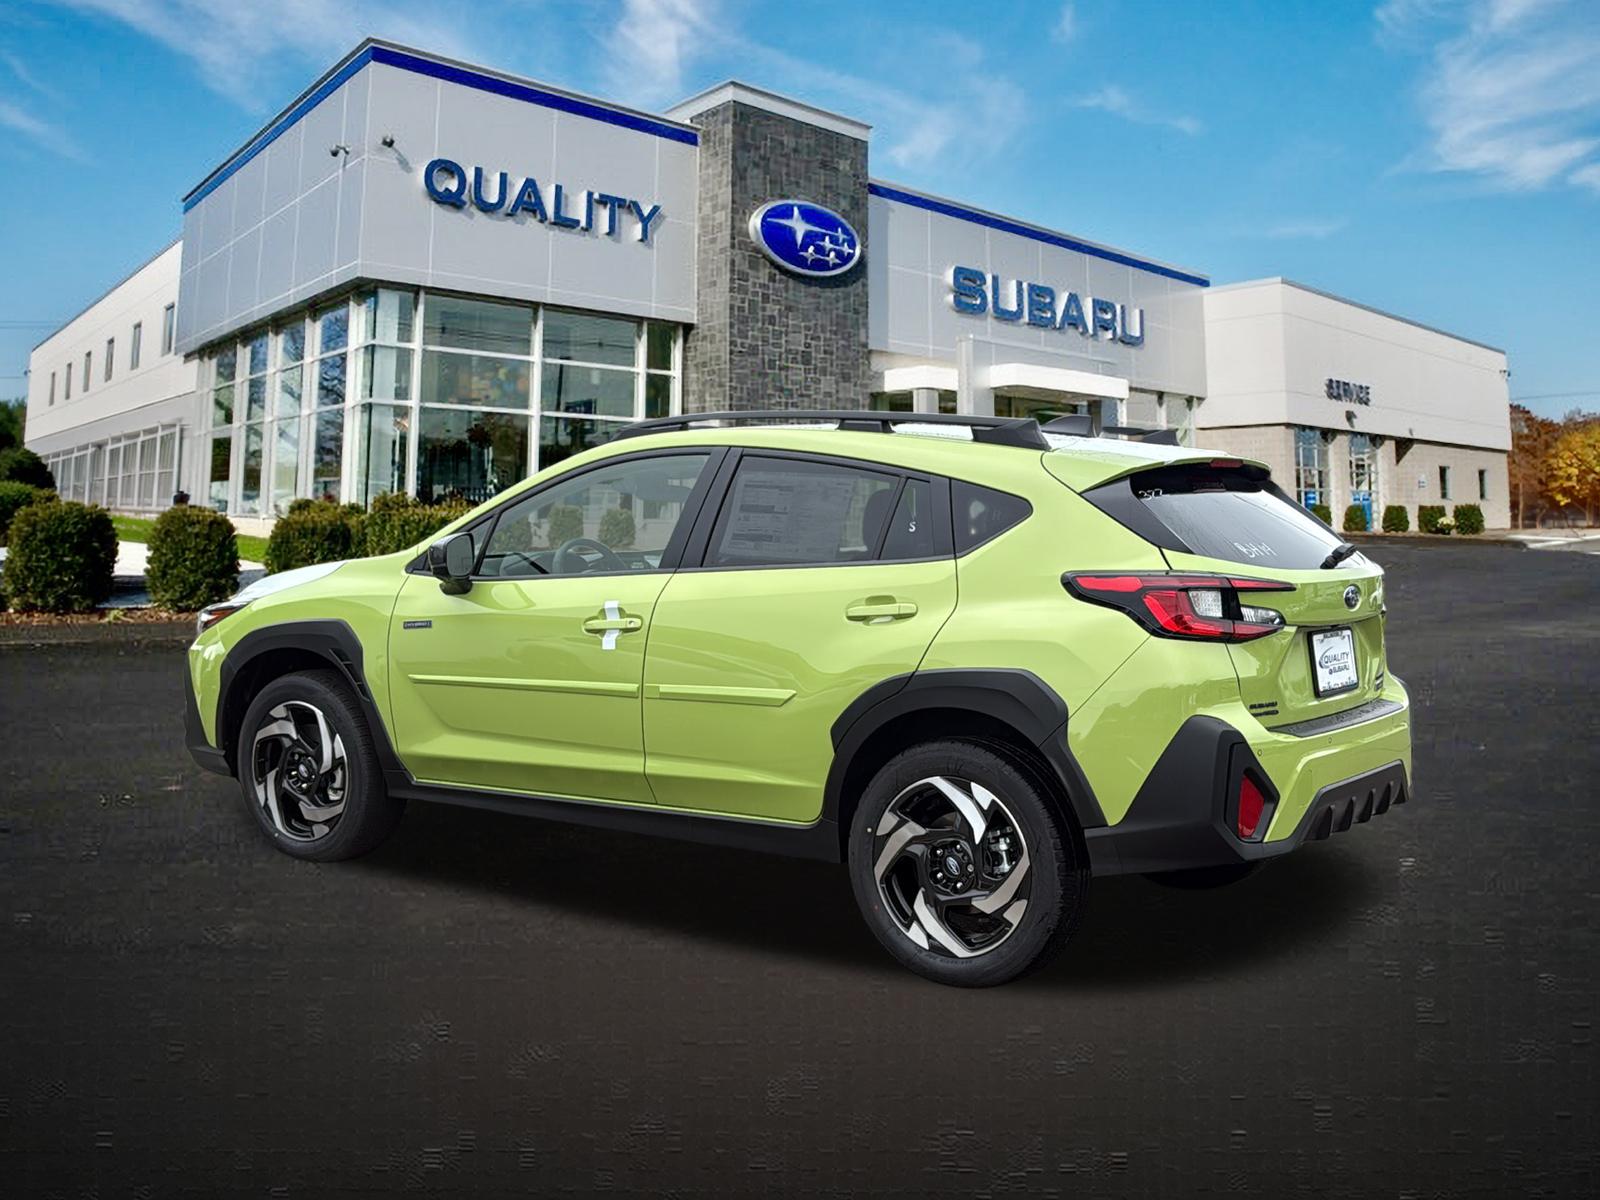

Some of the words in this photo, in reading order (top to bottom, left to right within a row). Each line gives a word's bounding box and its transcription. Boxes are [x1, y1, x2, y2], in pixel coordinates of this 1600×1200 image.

[424, 158, 661, 243] QUALITY
[951, 265, 1145, 347] SUBARU
[1325, 378, 1371, 406] SERVICE
[1323, 651, 1349, 664] QUALITY
